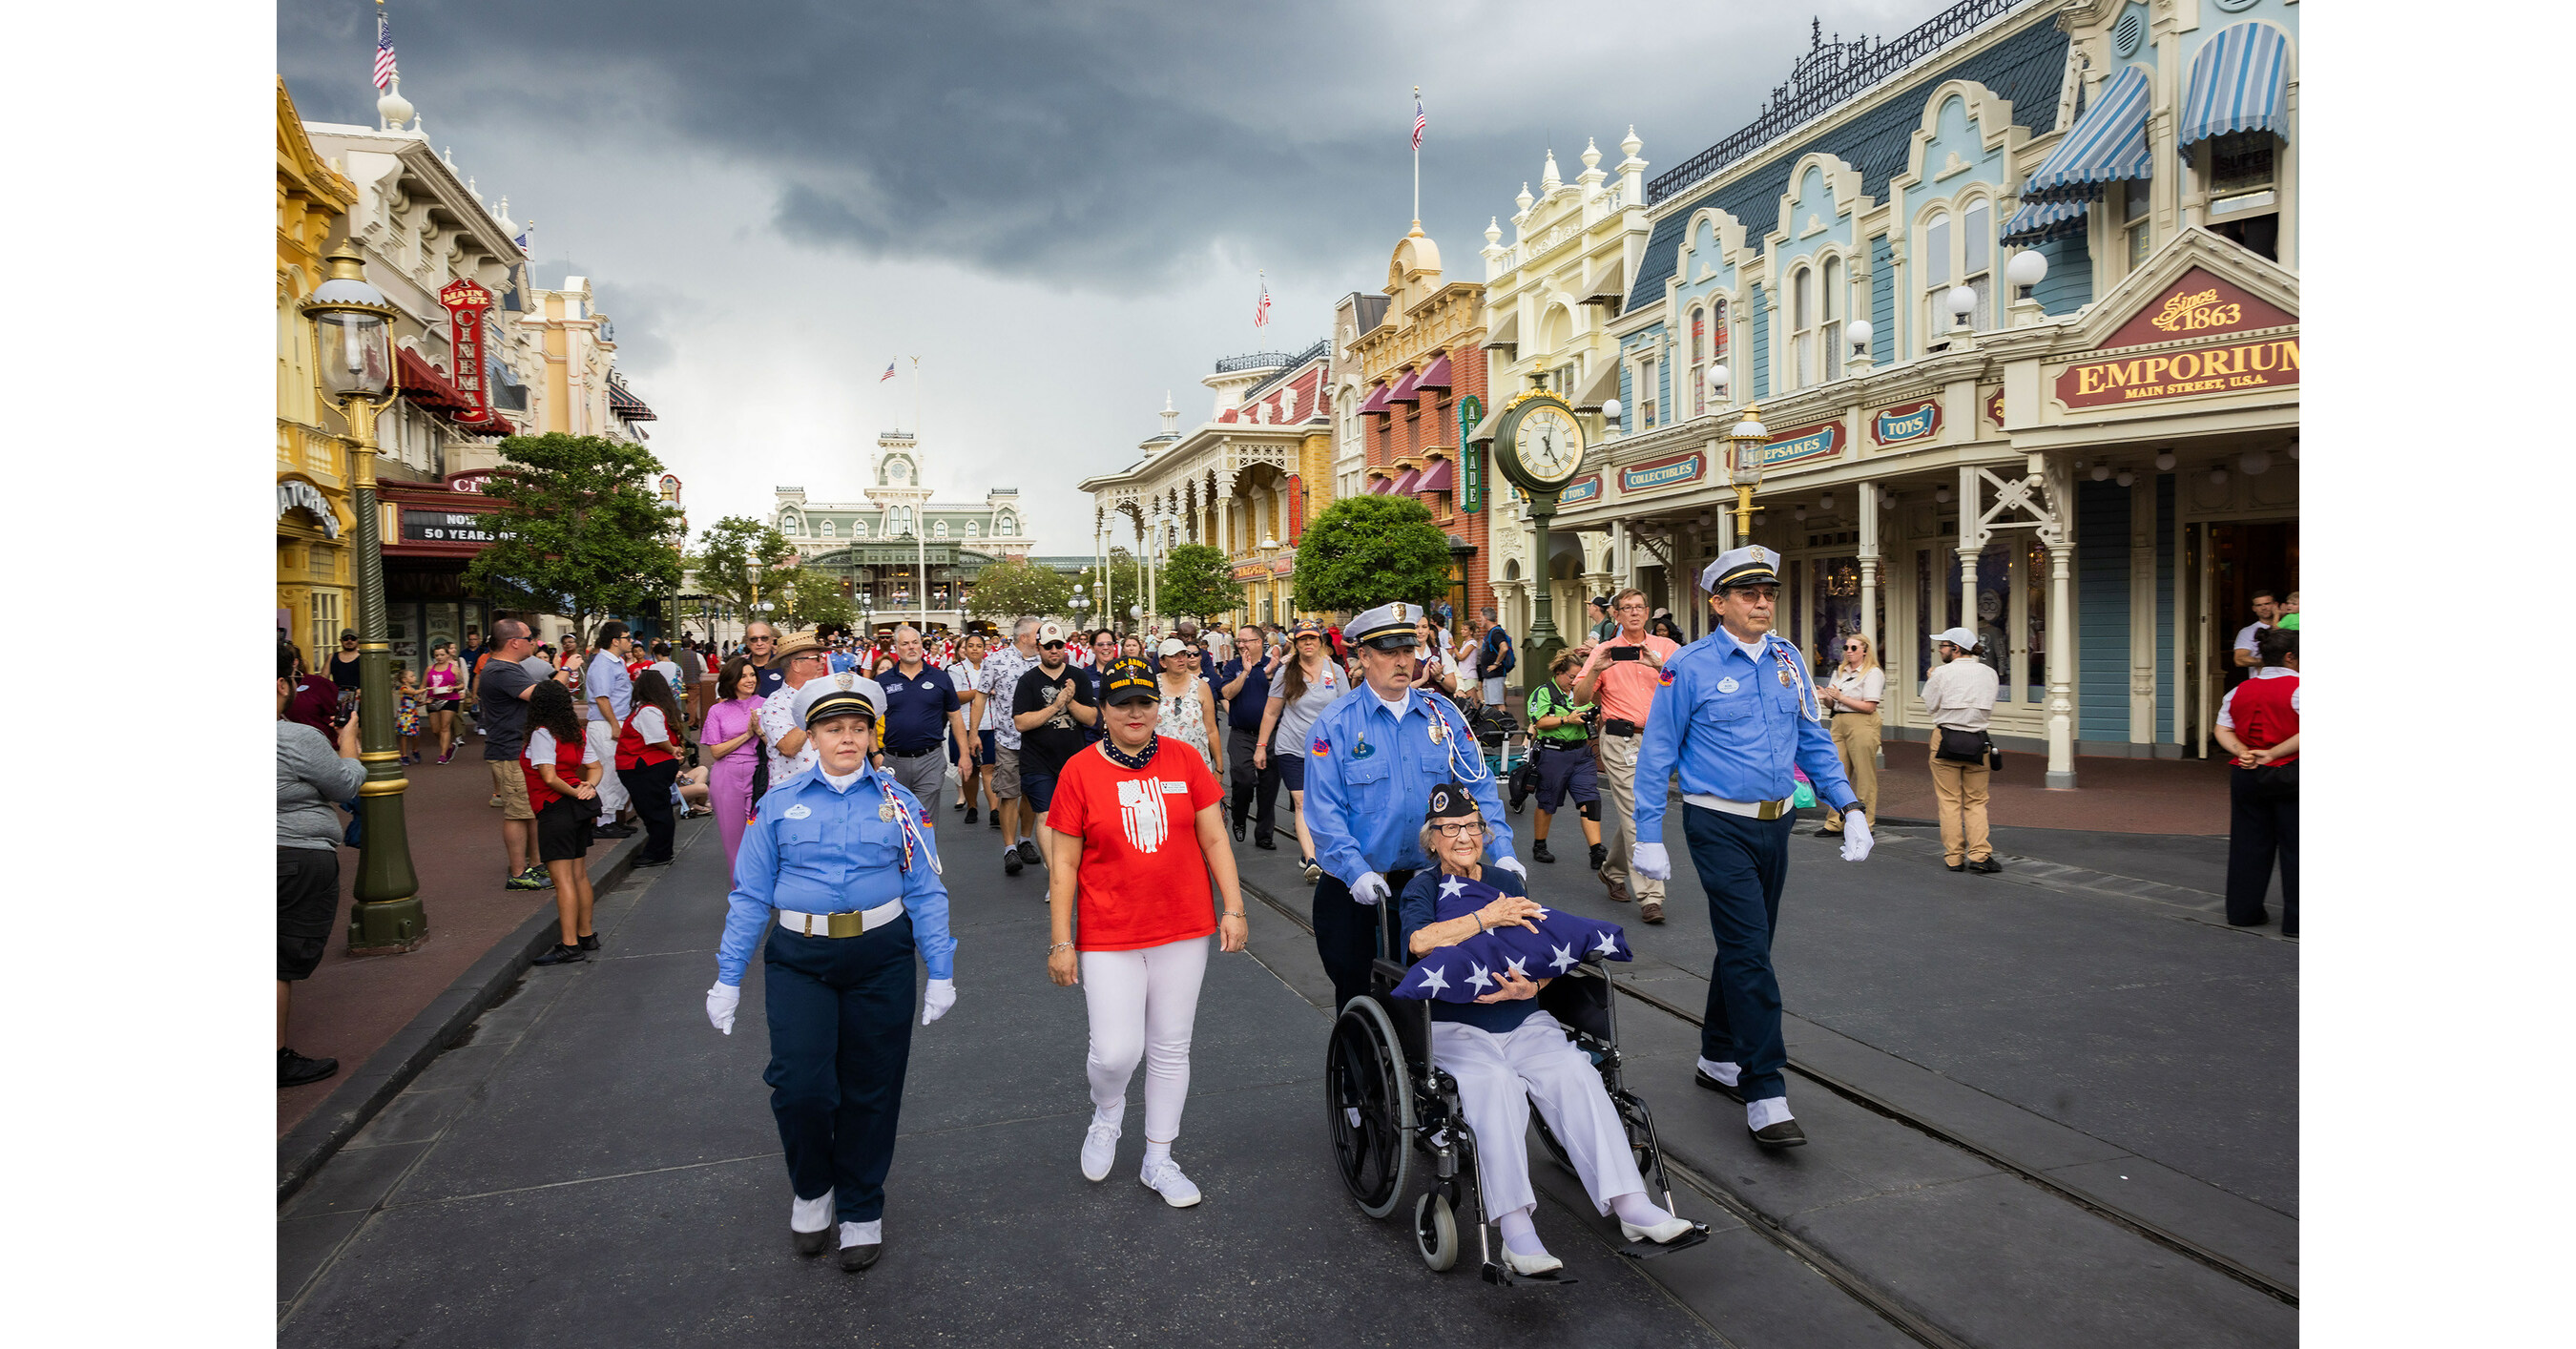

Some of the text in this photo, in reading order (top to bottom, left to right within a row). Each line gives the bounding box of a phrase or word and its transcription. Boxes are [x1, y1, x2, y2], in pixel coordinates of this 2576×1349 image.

[443, 290, 484, 302] MAIN
[2152, 288, 2219, 327] Since
[2182, 303, 2242, 331] 1863
[455, 309, 481, 407] CINEMA
[2125, 374, 2268, 399] MAIN STREET, U.S.A.
[1887, 416, 1924, 436] TOYS
[1630, 463, 1693, 486] COLLECTIBLES
[1568, 488, 1586, 498] TOYS
[425, 529, 444, 539] 50
[1114, 658, 1147, 670] U.S. ARMY
[1132, 678, 1154, 689] VETERAN
